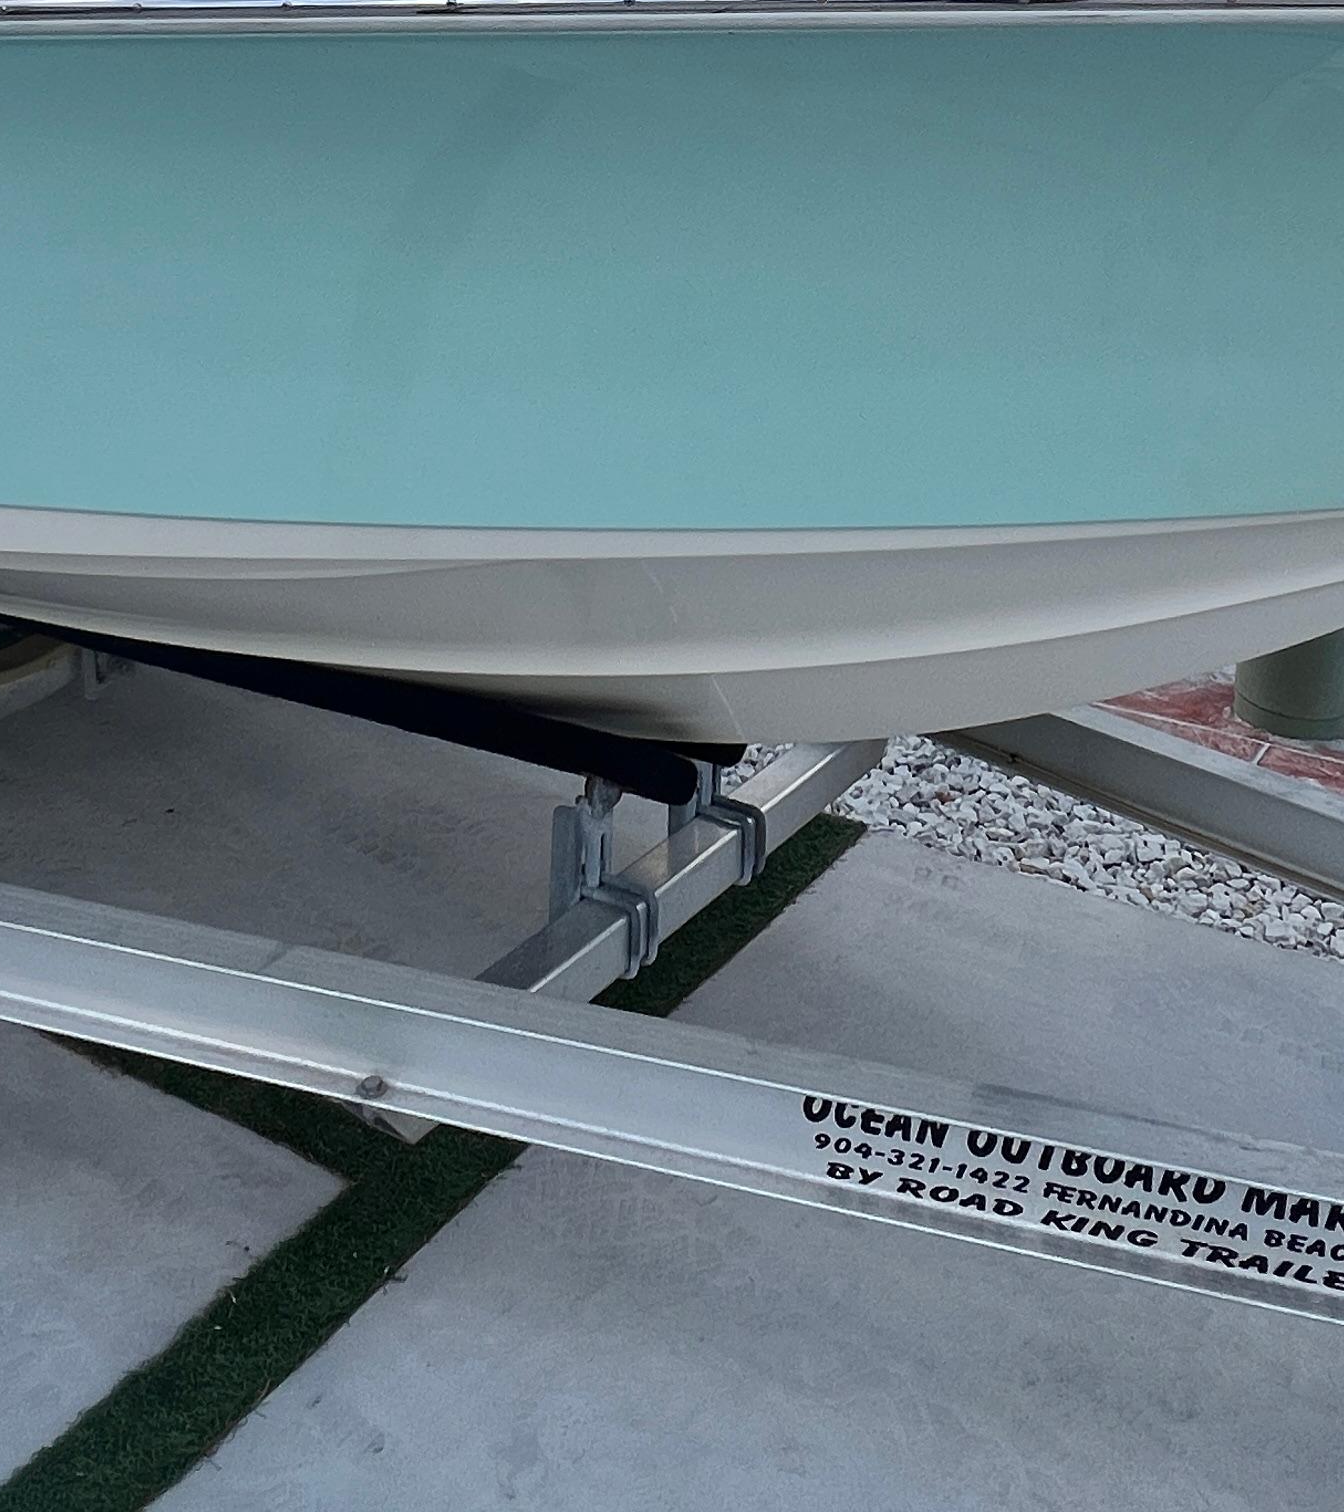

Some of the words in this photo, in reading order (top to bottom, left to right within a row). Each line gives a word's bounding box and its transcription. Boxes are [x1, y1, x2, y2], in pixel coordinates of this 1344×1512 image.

[803, 1094, 950, 1149] OCEAN
[814, 1133, 1031, 1194] 904-321-1422
[1043, 1181, 1249, 1242] FERNANDINA
[826, 1161, 884, 1186] BY
[897, 1177, 1024, 1217] ROAD
[1040, 1209, 1159, 1248] KING
